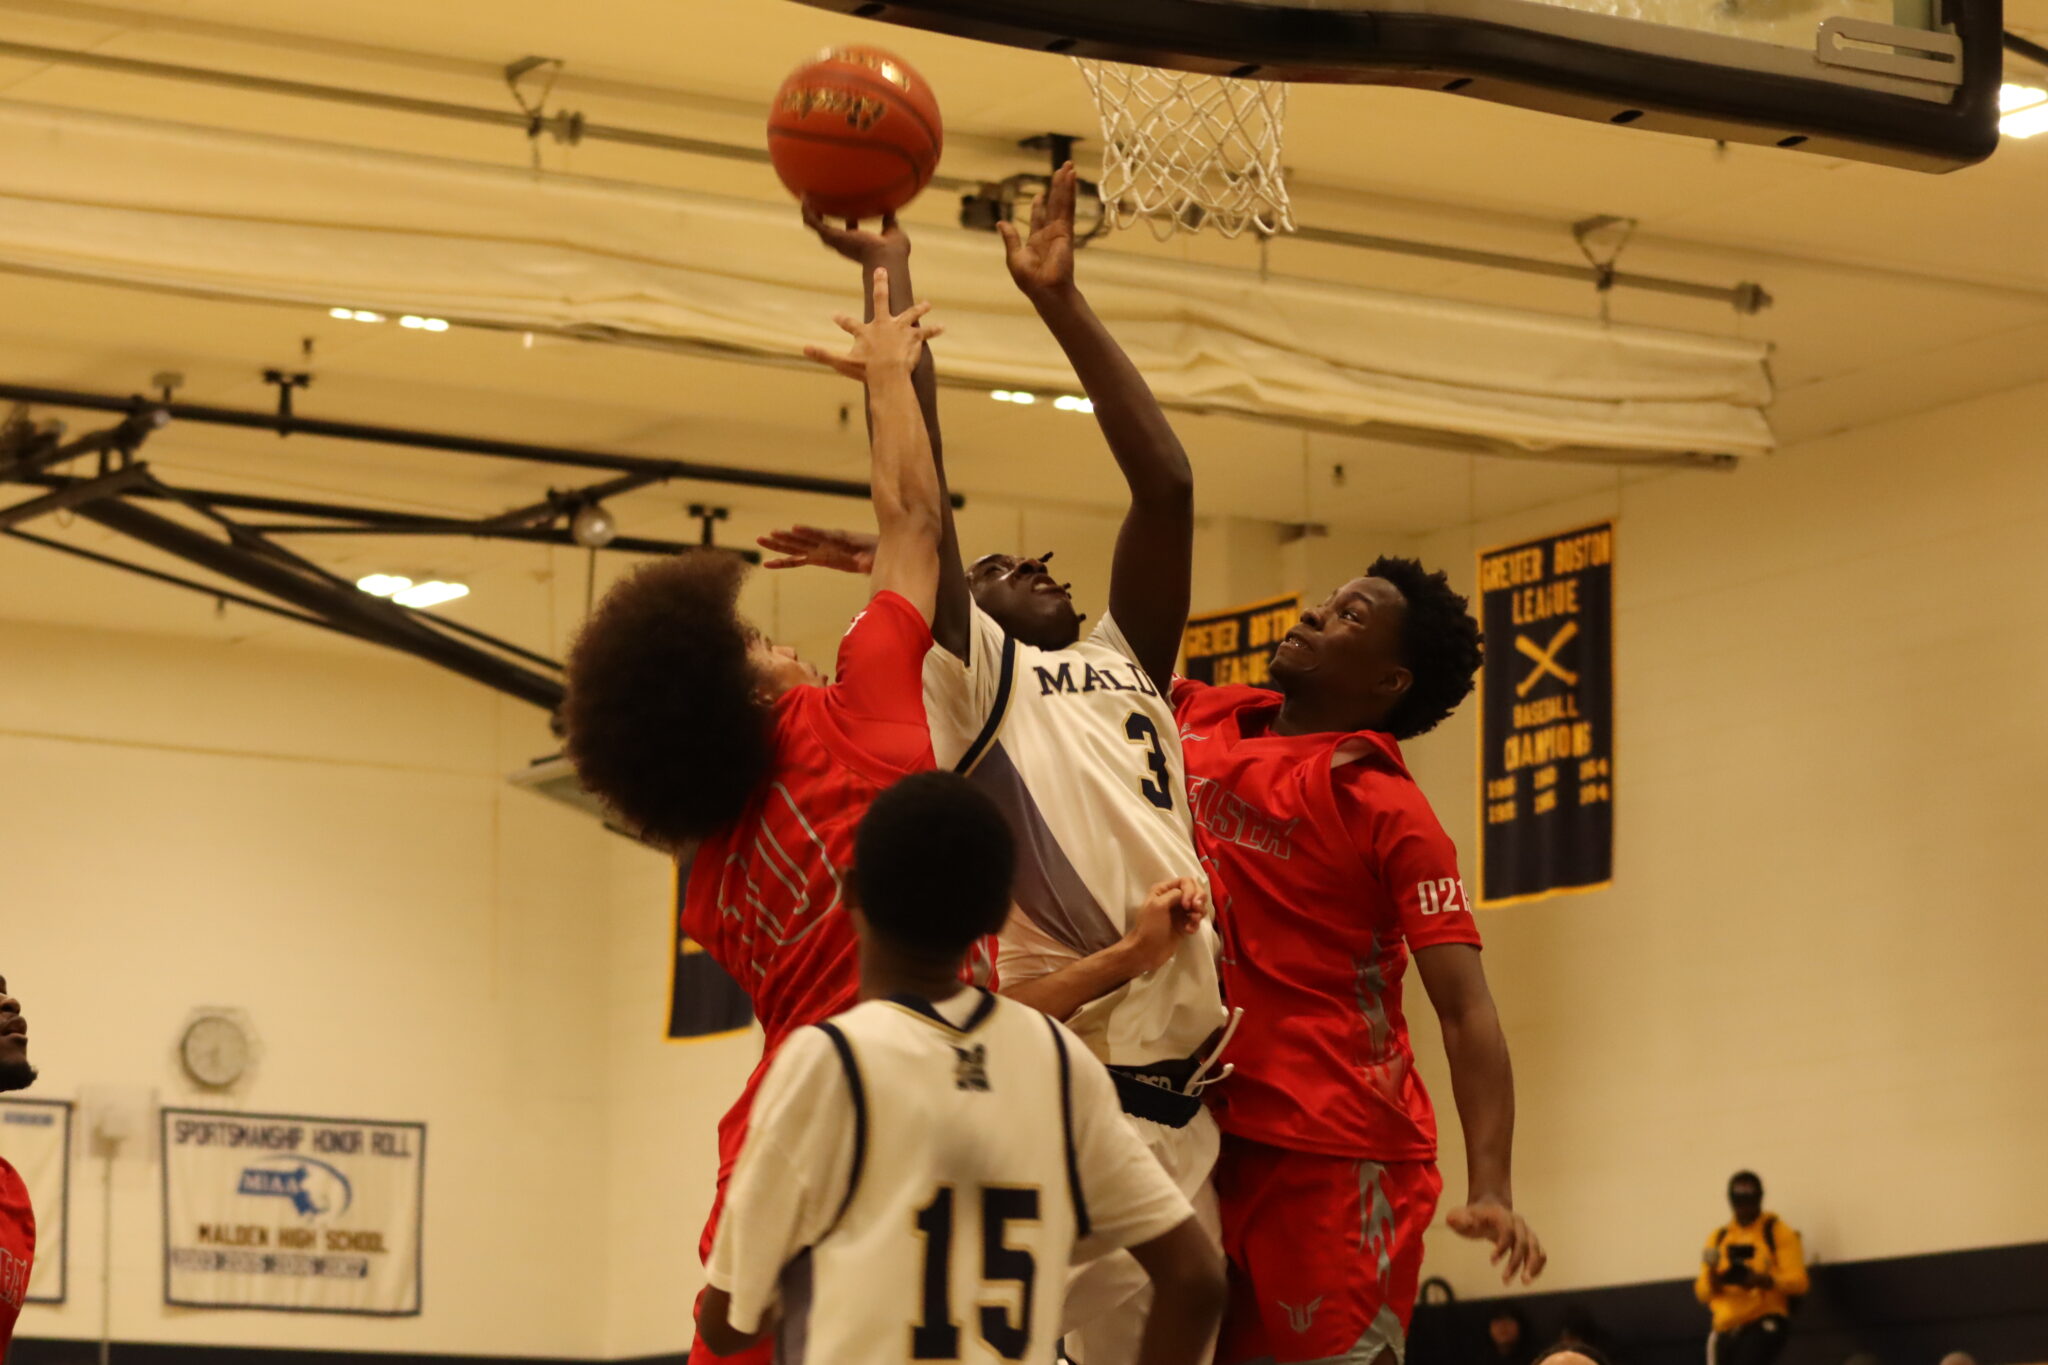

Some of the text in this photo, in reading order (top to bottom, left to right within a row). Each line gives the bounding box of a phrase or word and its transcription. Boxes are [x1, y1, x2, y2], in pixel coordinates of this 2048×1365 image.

[1122, 710, 1174, 814] 3
[313, 1129, 363, 1153] HONOR
[371, 1132, 411, 1157] ROLL
[198, 1224, 388, 1253] MALDEN HIGH SCHOOL
[909, 1183, 1042, 1361] 15
